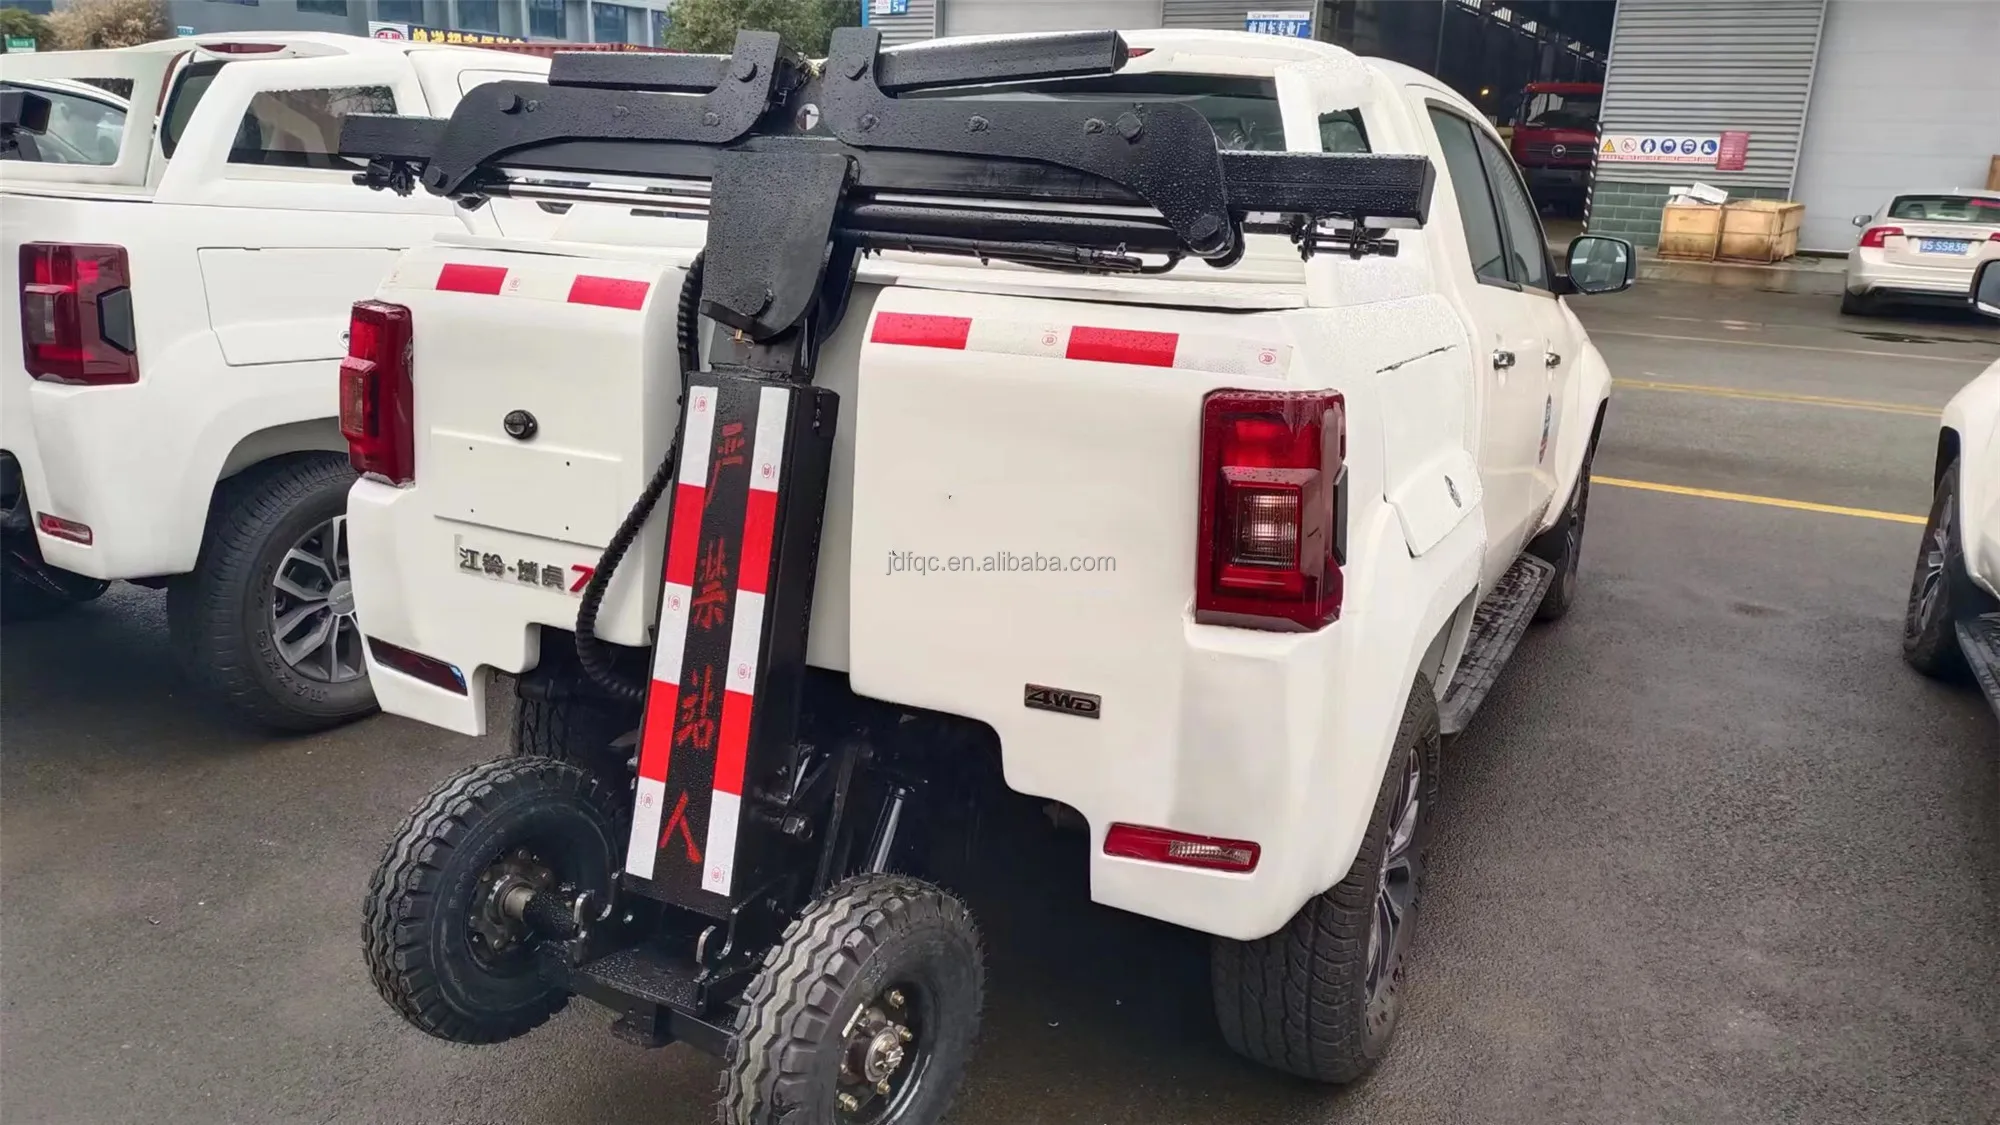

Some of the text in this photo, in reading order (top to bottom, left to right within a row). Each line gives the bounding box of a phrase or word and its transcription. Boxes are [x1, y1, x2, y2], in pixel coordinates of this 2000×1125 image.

[659, 422, 746, 864] 严禁站人
[1026, 688, 1098, 712] 4WD
